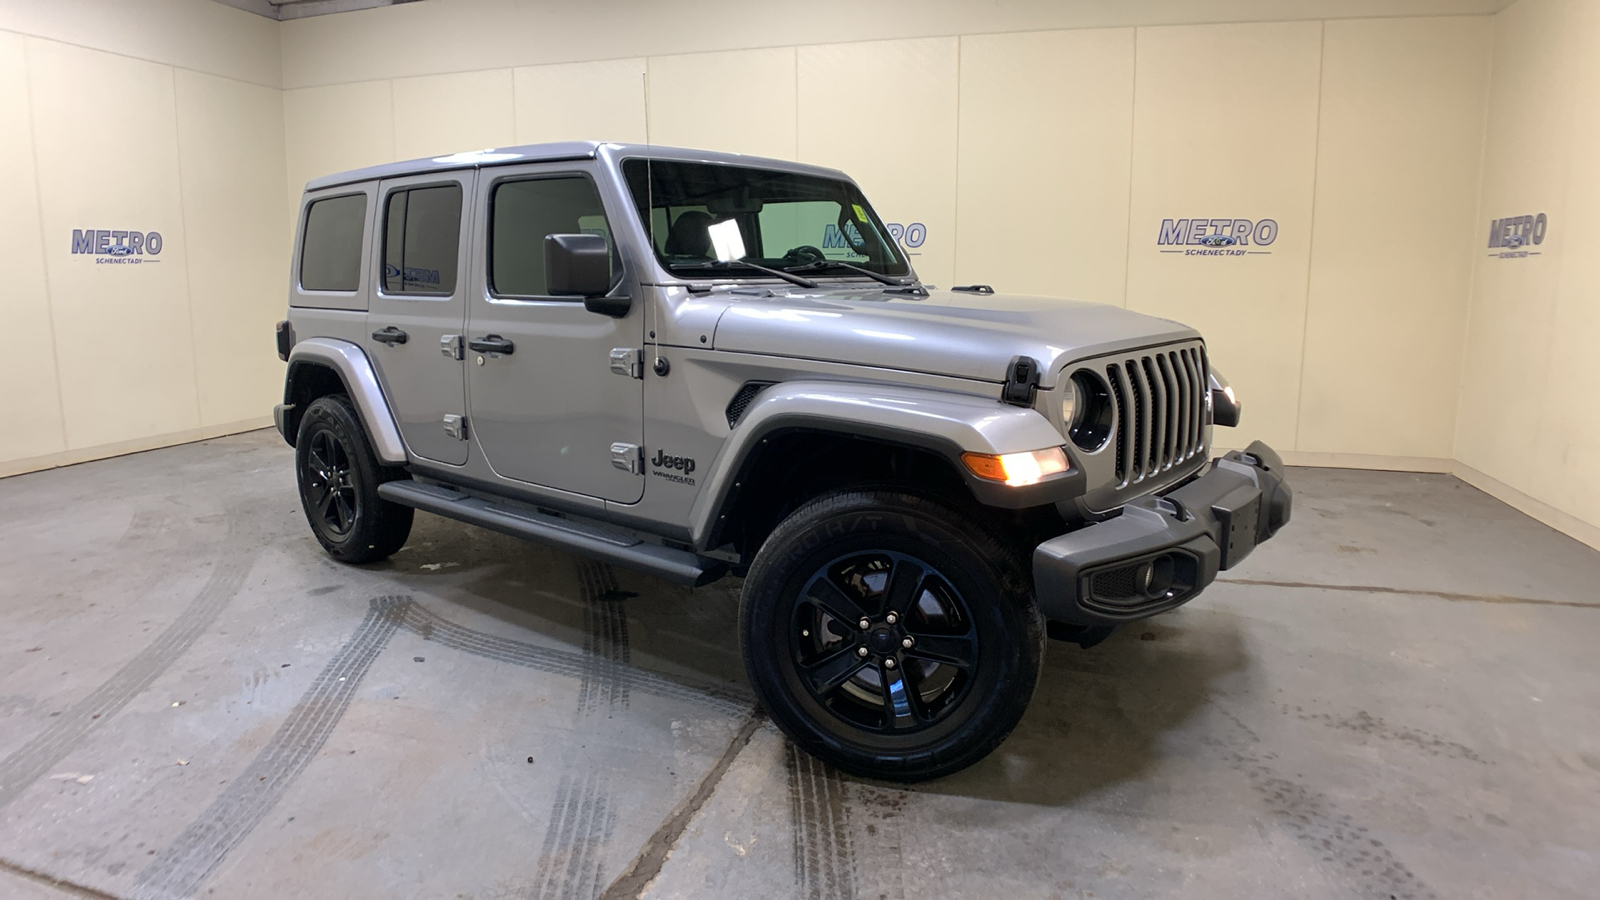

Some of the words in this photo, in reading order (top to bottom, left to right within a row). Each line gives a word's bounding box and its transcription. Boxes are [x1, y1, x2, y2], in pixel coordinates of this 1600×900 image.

[71, 229, 162, 255] METRO
[822, 222, 926, 248] MERO
[1157, 218, 1278, 246] METRO
[1487, 213, 1547, 248] METRO
[651, 449, 695, 475] Jeep
[652, 470, 695, 484] WRANGLER
